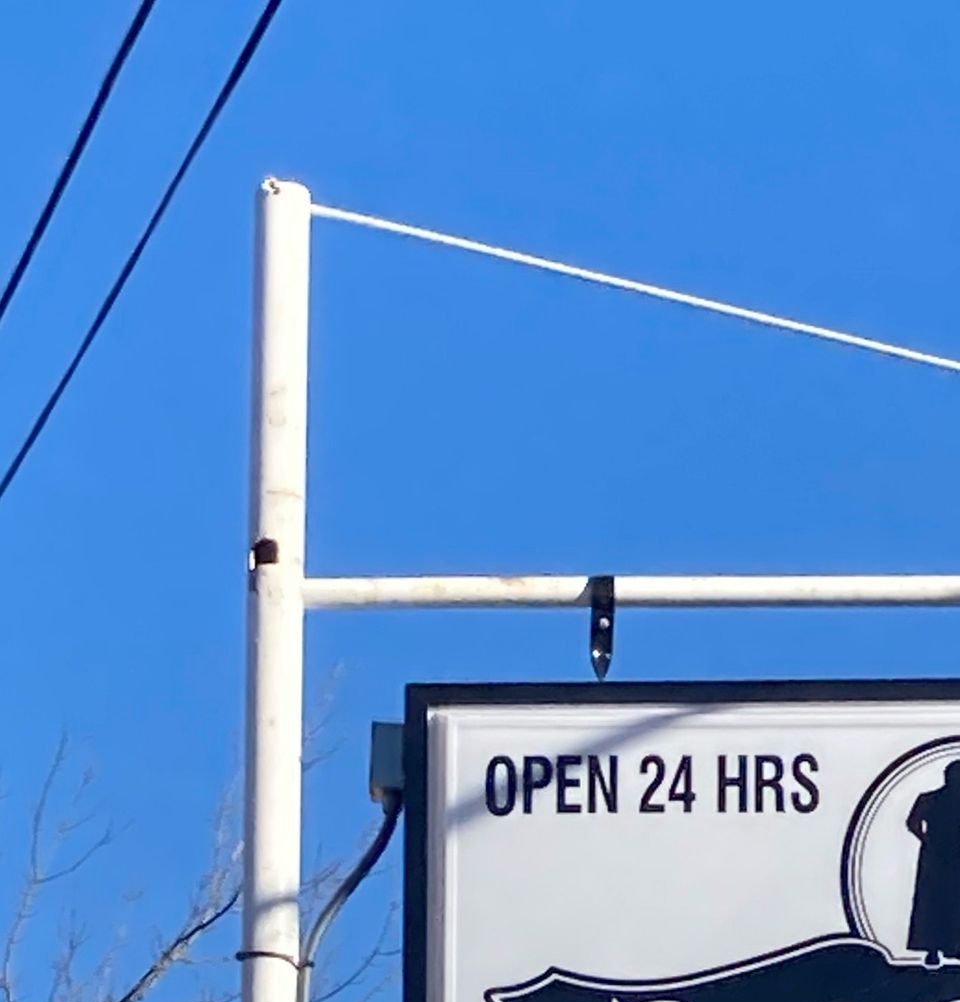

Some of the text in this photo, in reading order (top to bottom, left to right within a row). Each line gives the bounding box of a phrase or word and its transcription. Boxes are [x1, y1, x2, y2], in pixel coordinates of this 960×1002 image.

[484, 753, 819, 817] OPEN 24 HRS
